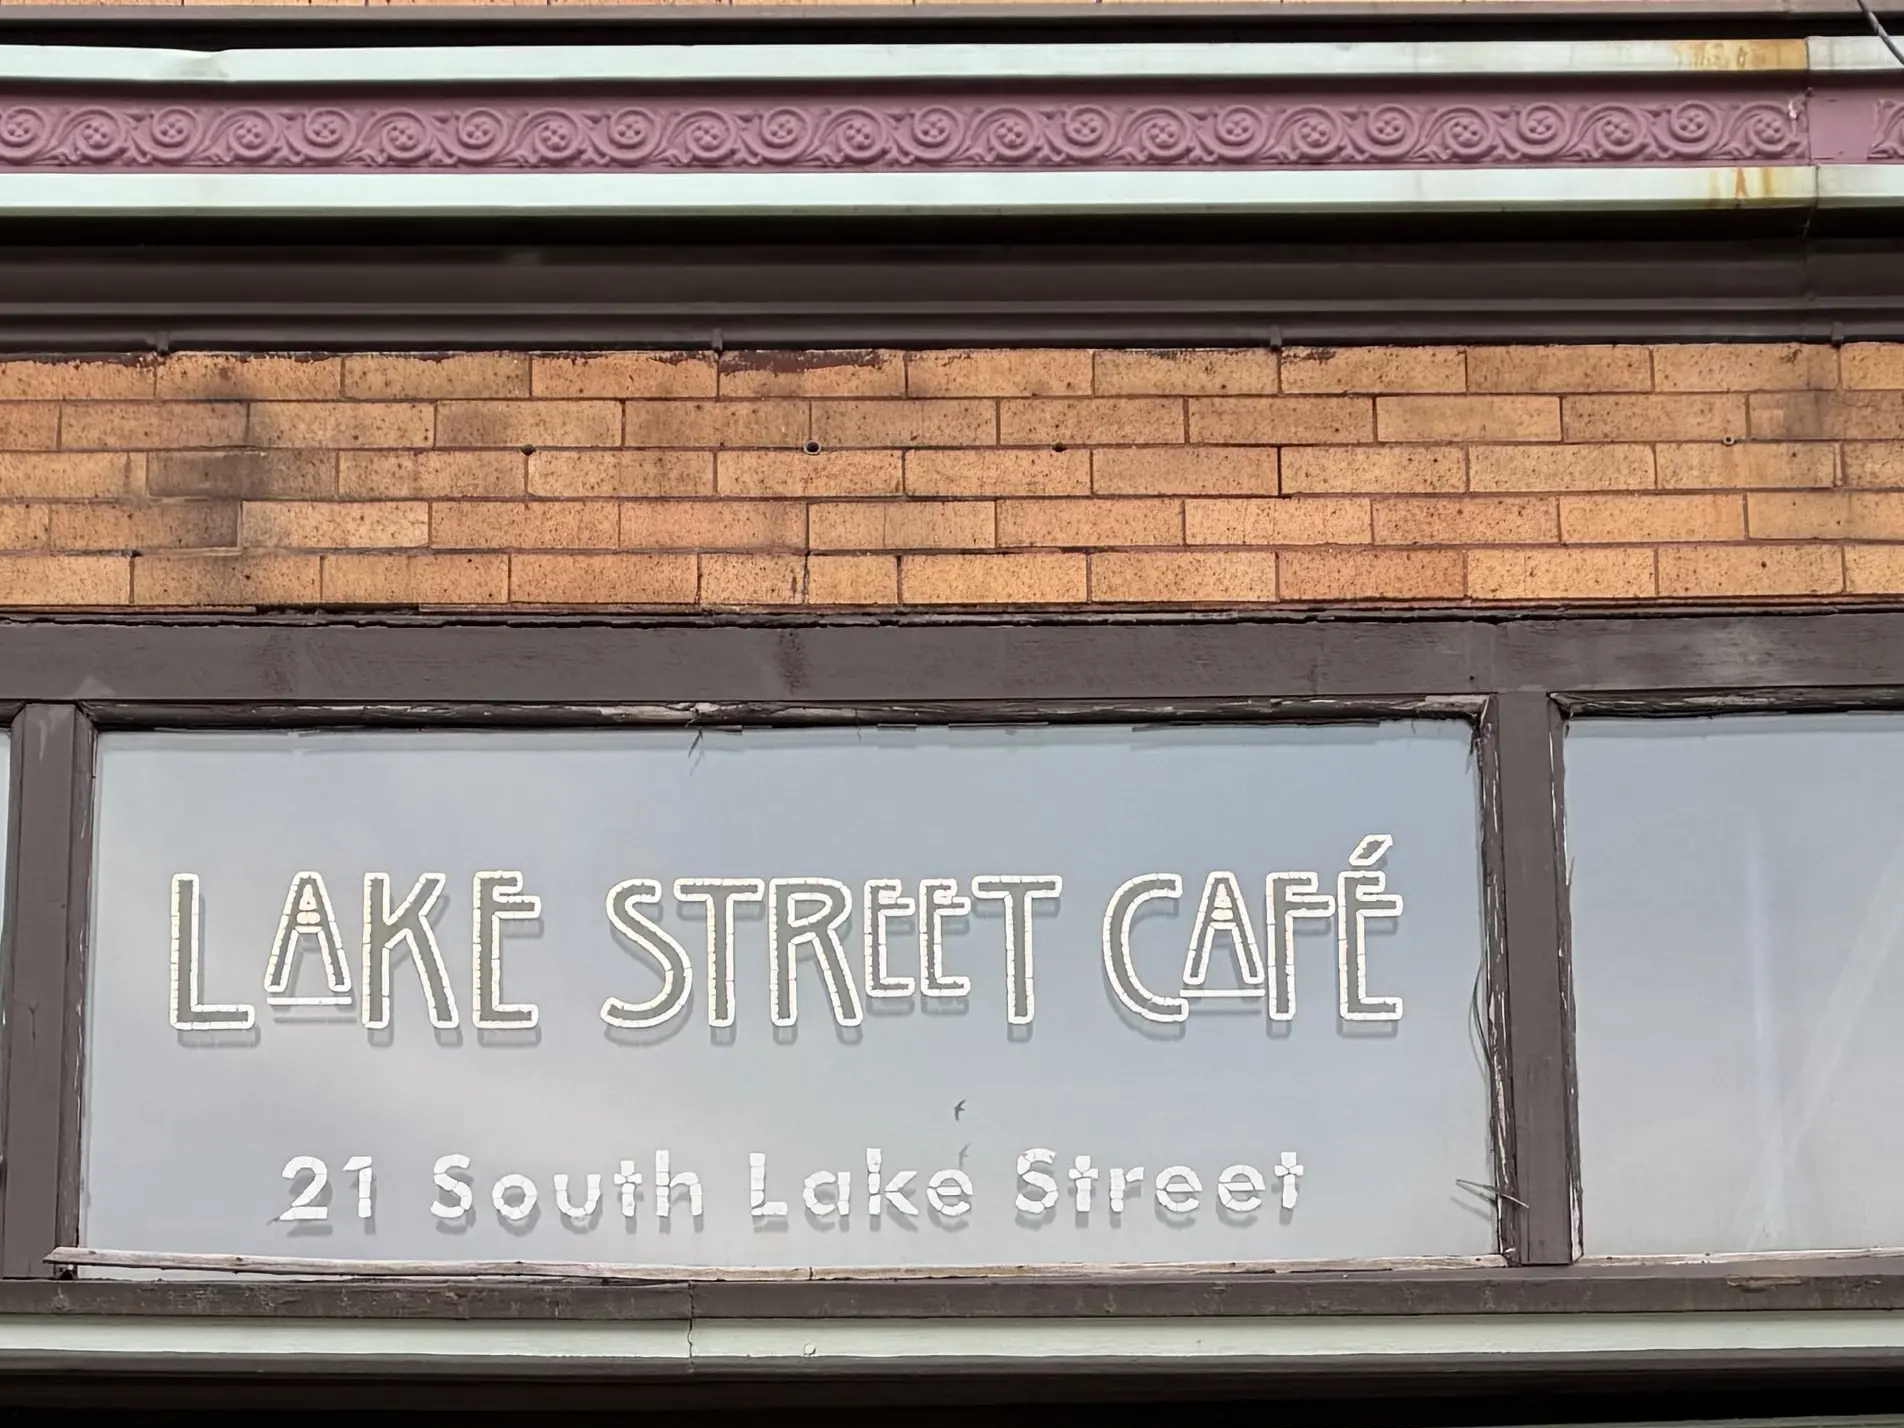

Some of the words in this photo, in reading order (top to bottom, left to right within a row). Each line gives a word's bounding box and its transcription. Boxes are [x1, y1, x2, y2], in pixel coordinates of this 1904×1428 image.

[168, 869, 544, 1032] LAKE
[601, 872, 1062, 1029] STREET
[1102, 834, 1405, 1022] CAFÉ
[277, 1155, 375, 1221] 21
[430, 1150, 706, 1220] South
[748, 1148, 974, 1218] Lake
[1015, 1146, 1305, 1215] Street
